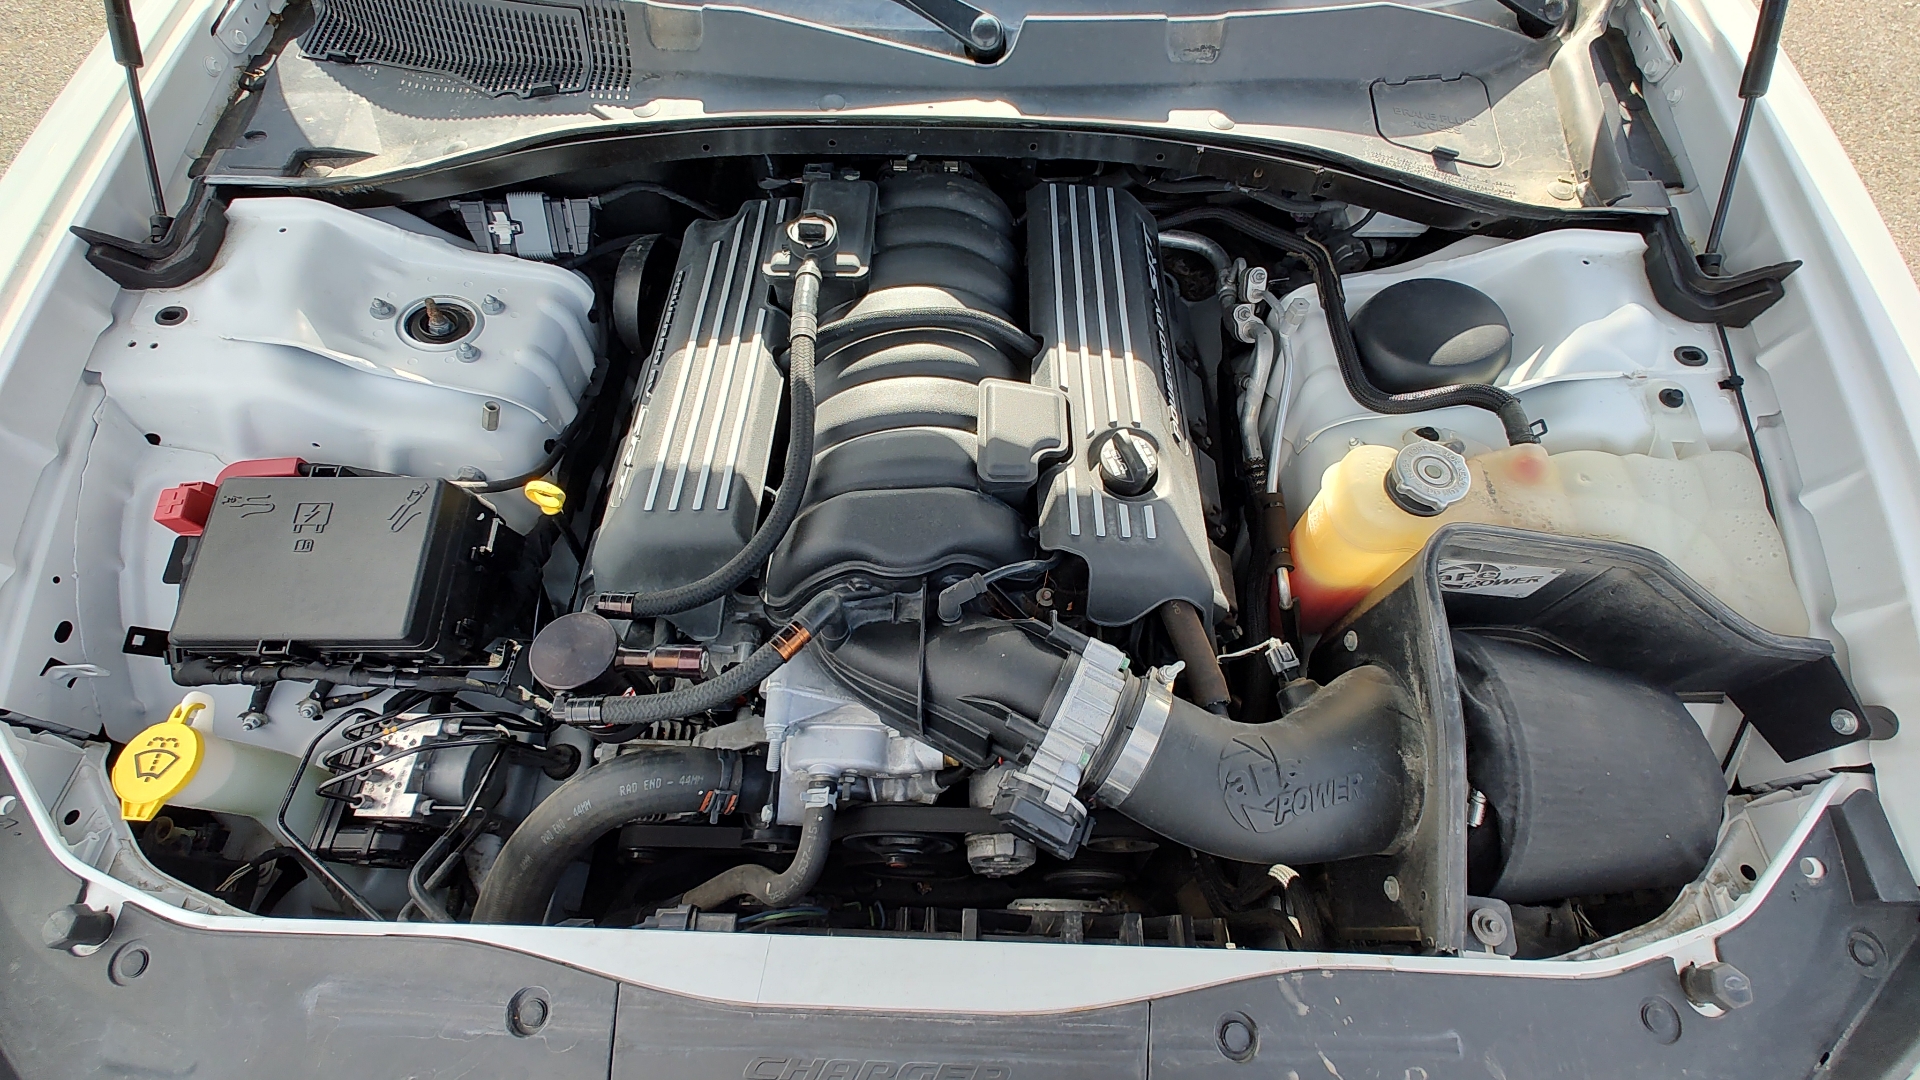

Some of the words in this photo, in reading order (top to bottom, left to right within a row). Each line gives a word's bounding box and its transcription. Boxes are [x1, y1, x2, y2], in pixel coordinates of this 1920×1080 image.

[1392, 107, 1438, 122] BRAKE
[1438, 114, 1478, 127] FLUID
[1410, 121, 1462, 135] ACCESS
[1142, 221, 1160, 301] SRT
[1159, 329, 1182, 442] POWERED
[1462, 575, 1544, 590] POWER
[619, 782, 638, 797] RAD
[643, 778, 662, 791] END
[679, 775, 704, 786] 44MM
[1273, 771, 1364, 827] POWER
[540, 829, 555, 846] RAD
[552, 818, 566, 835] END
[573, 799, 592, 817] 44MM
